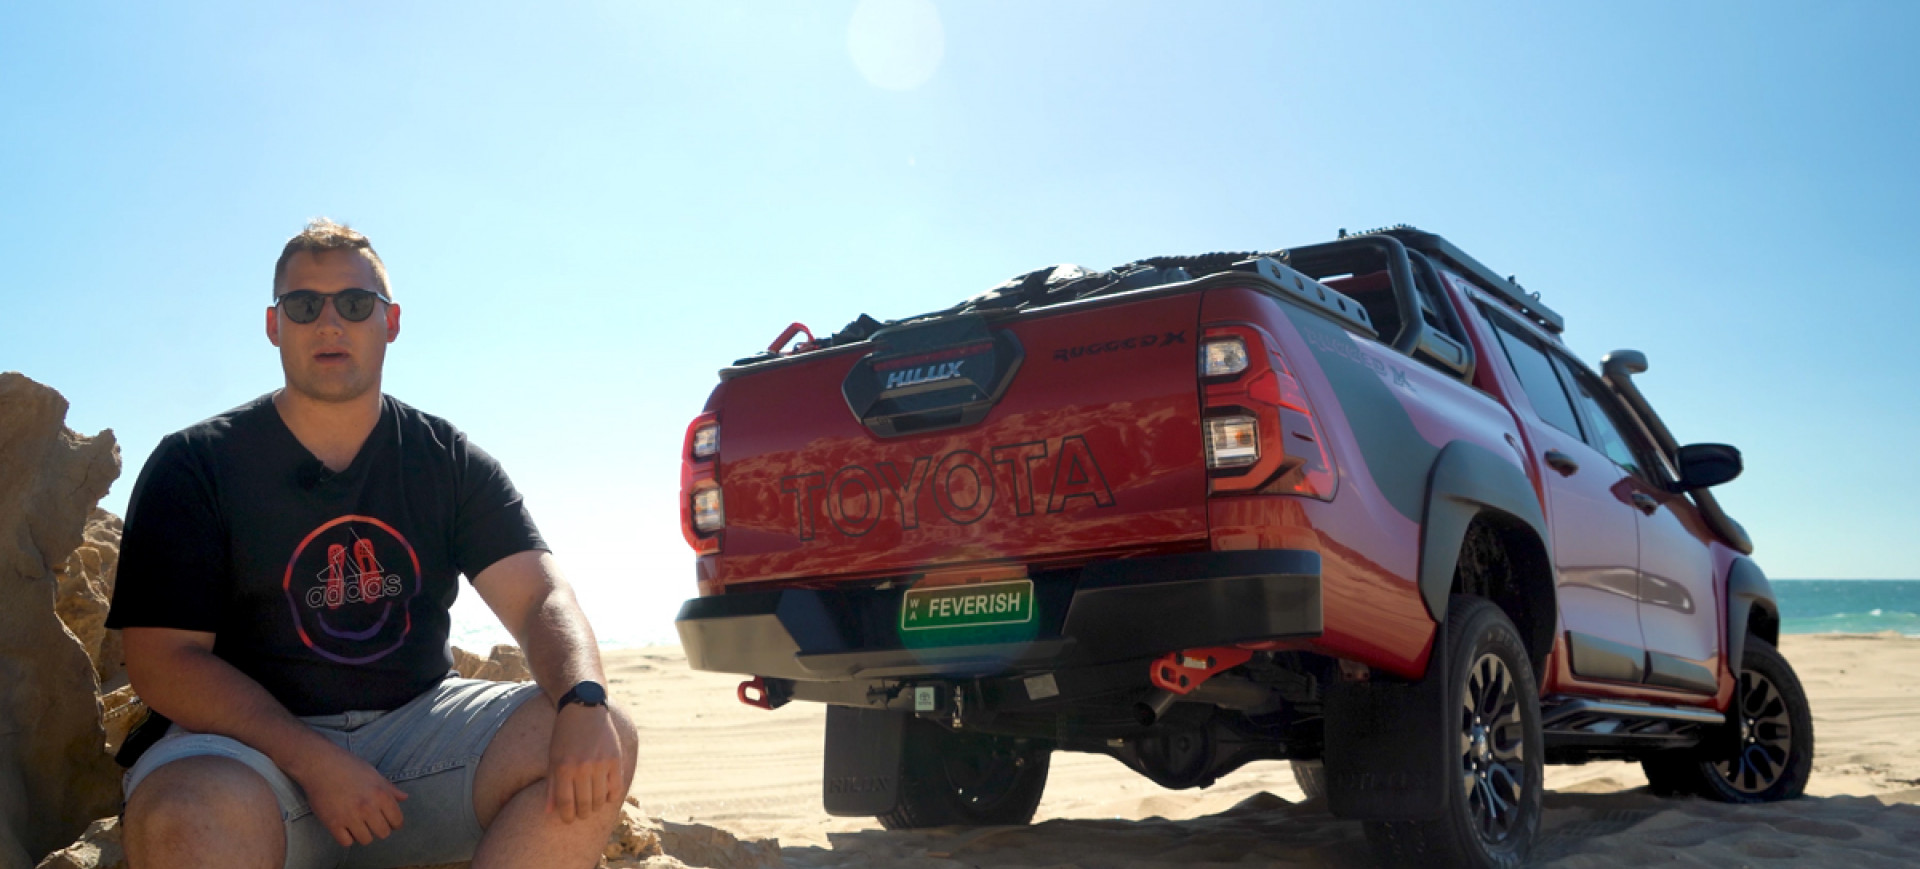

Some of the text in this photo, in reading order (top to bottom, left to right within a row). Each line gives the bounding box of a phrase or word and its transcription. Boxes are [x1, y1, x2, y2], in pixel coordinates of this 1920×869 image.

[1053, 329, 1187, 362] RUGGED X
[886, 359, 967, 390] HILUX
[780, 434, 1116, 543] TOYOTA
[306, 573, 402, 609] addas
[928, 591, 1022, 619] FEVERISH
